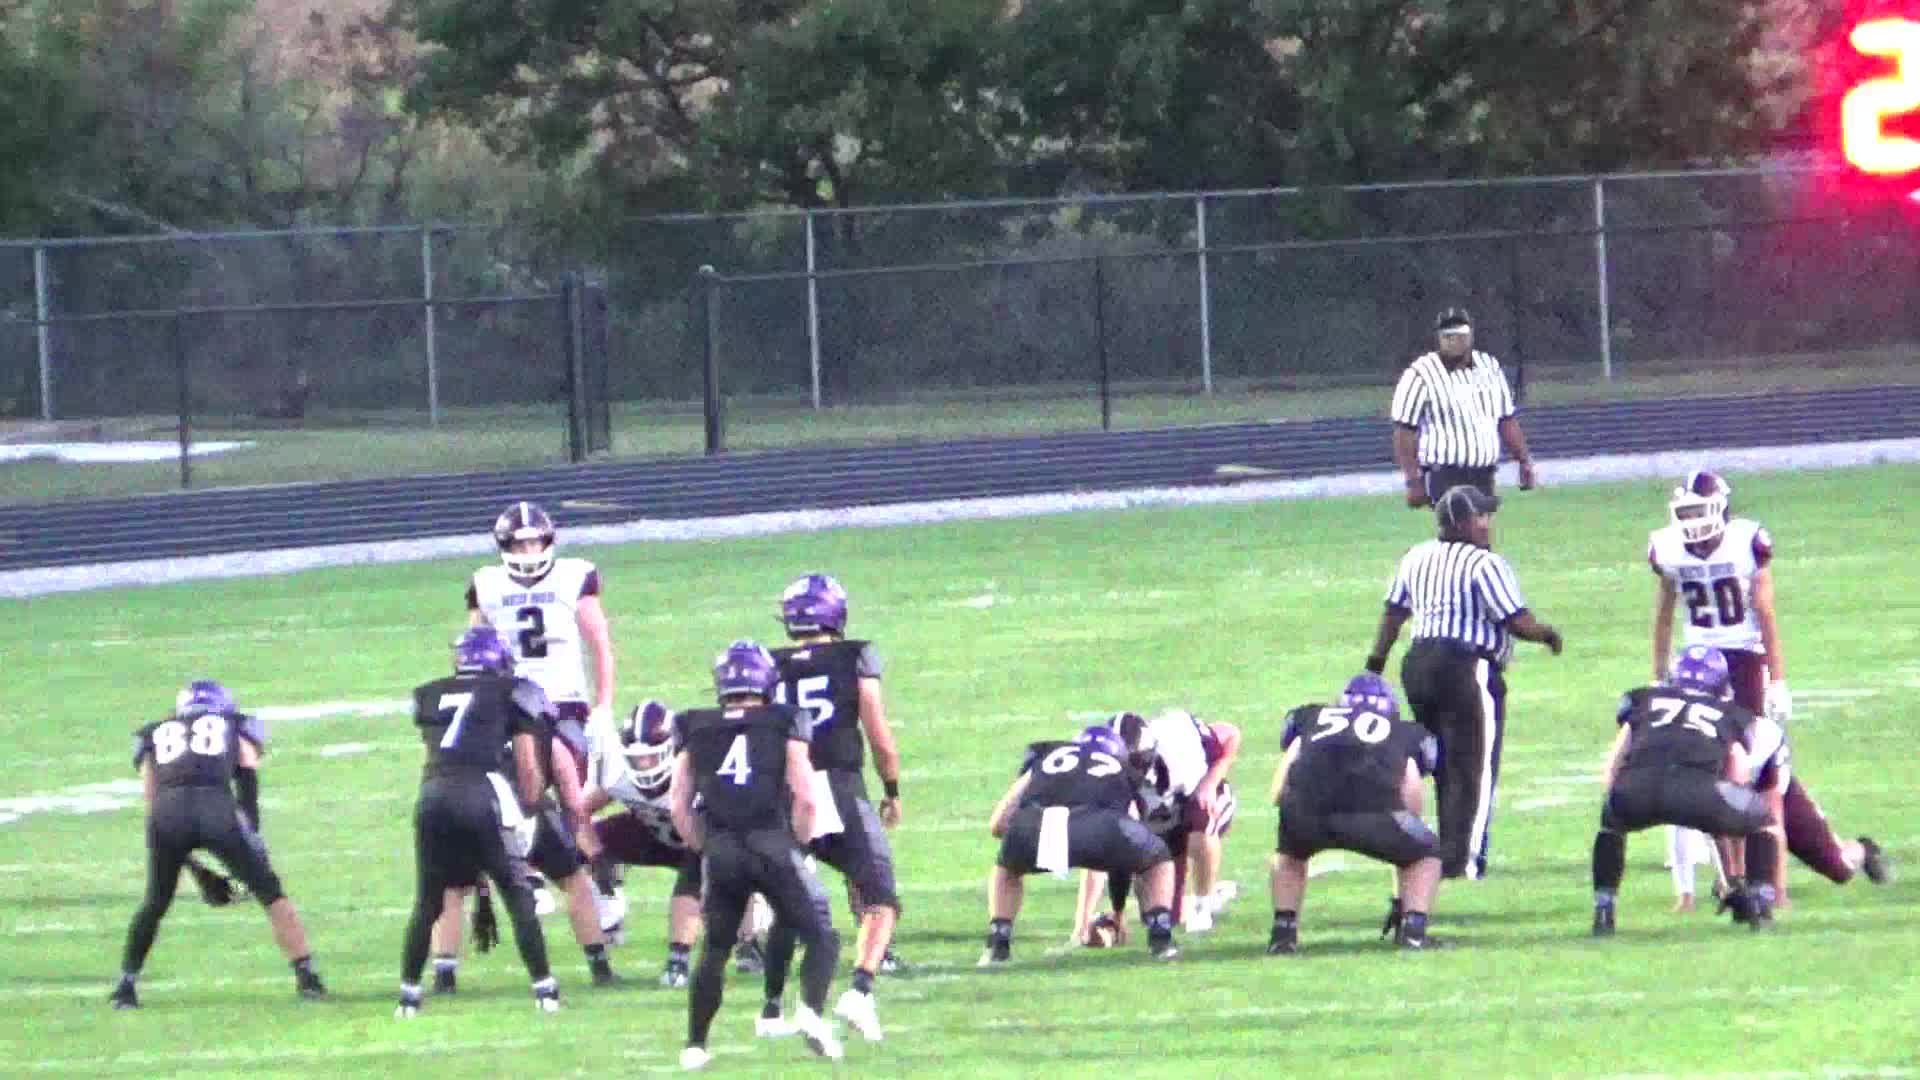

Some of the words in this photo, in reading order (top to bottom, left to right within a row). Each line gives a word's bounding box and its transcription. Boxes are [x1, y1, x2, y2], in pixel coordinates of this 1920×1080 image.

[1842, 17, 1920, 174] 2
[1681, 576, 1744, 628] 20
[516, 606, 548, 658] 2
[438, 692, 473, 749] 7
[1311, 708, 1391, 743] 50
[1651, 697, 1723, 737] 75
[716, 734, 752, 784] 4
